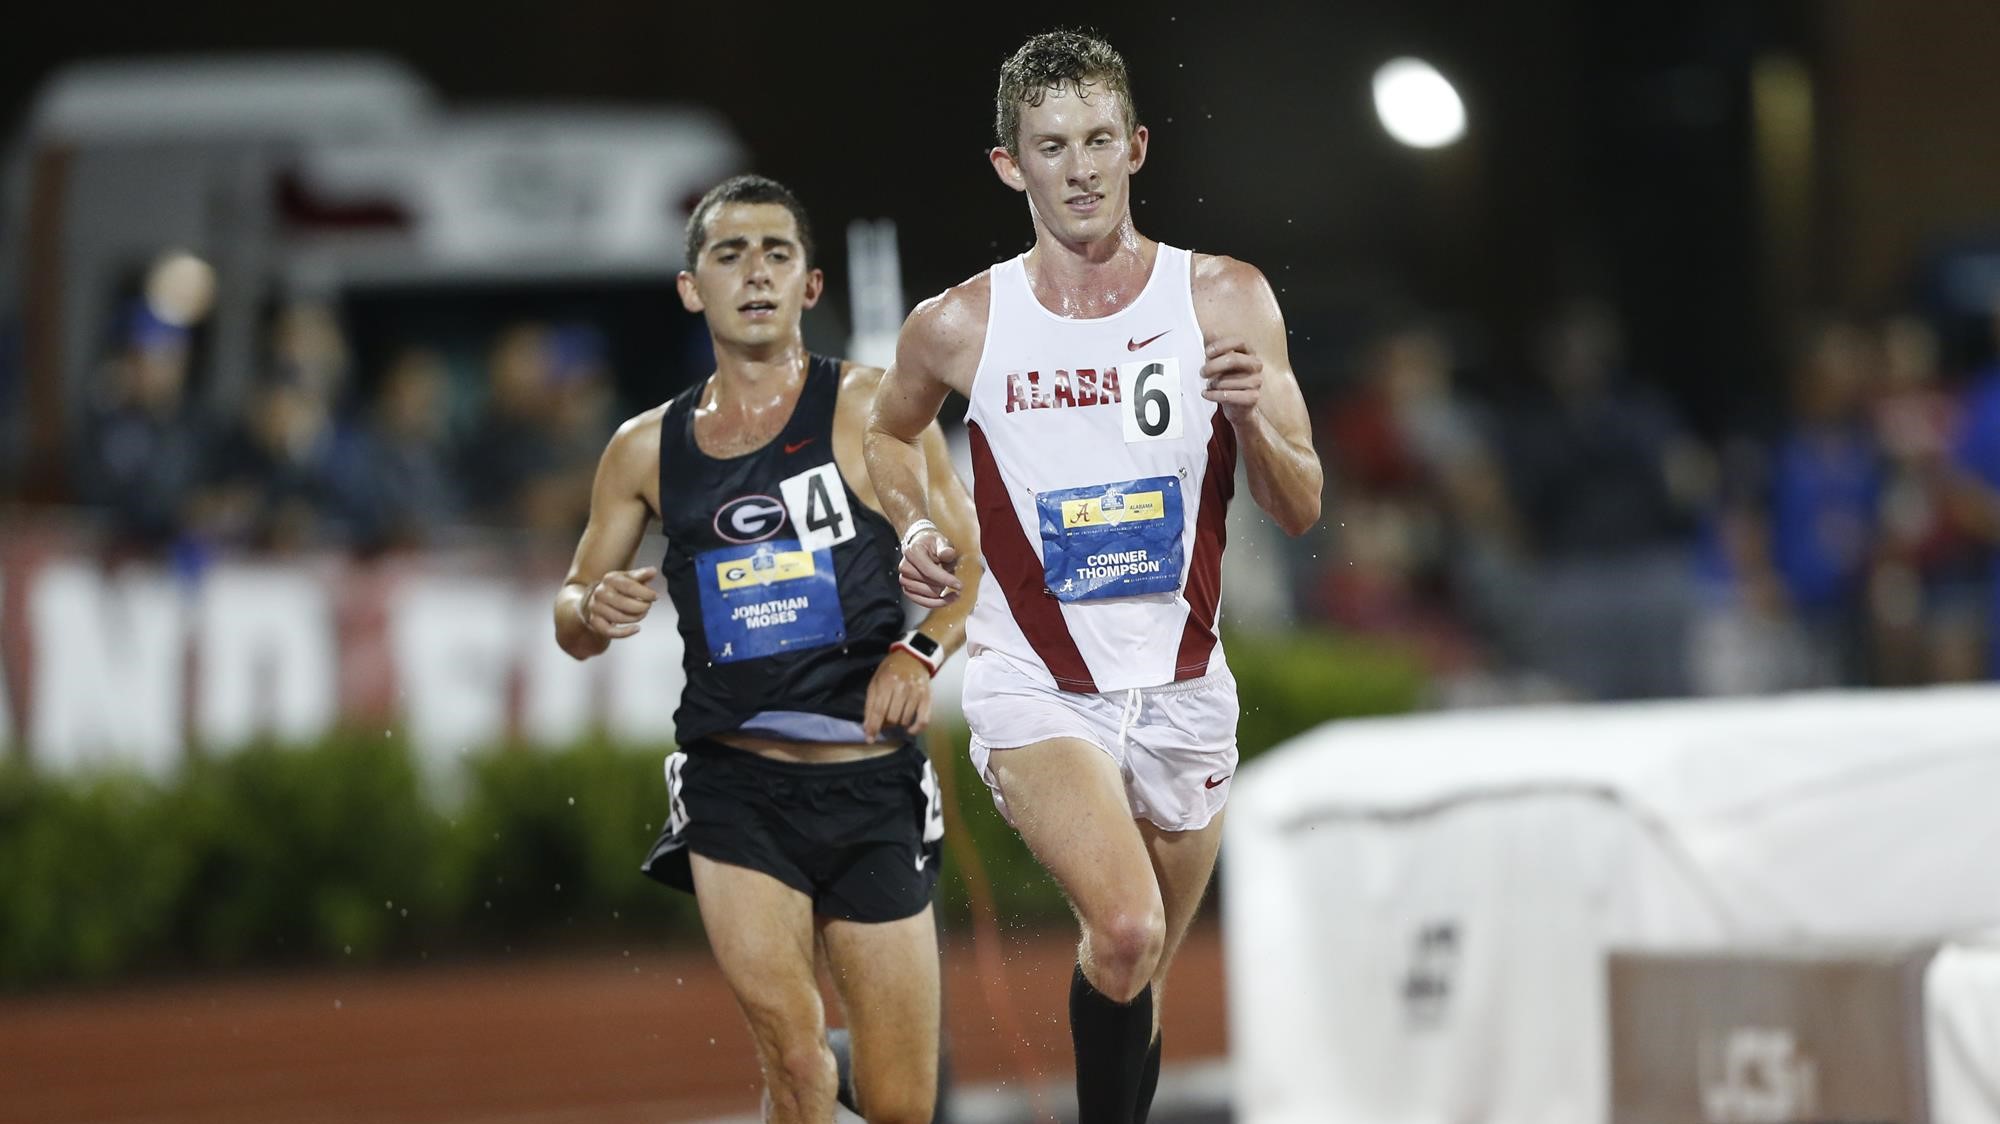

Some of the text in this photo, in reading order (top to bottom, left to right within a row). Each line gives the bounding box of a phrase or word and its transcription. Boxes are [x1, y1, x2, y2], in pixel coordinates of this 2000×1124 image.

[1005, 367, 1122, 414] ALABA
[1134, 363, 1171, 437] 6
[731, 502, 784, 534] G
[806, 473, 843, 539] 4
[1076, 560, 1160, 580] THOMPSON
[1087, 550, 1147, 567] CONNER
[731, 596, 809, 620] JONATHAN
[745, 610, 798, 629] MOSES
